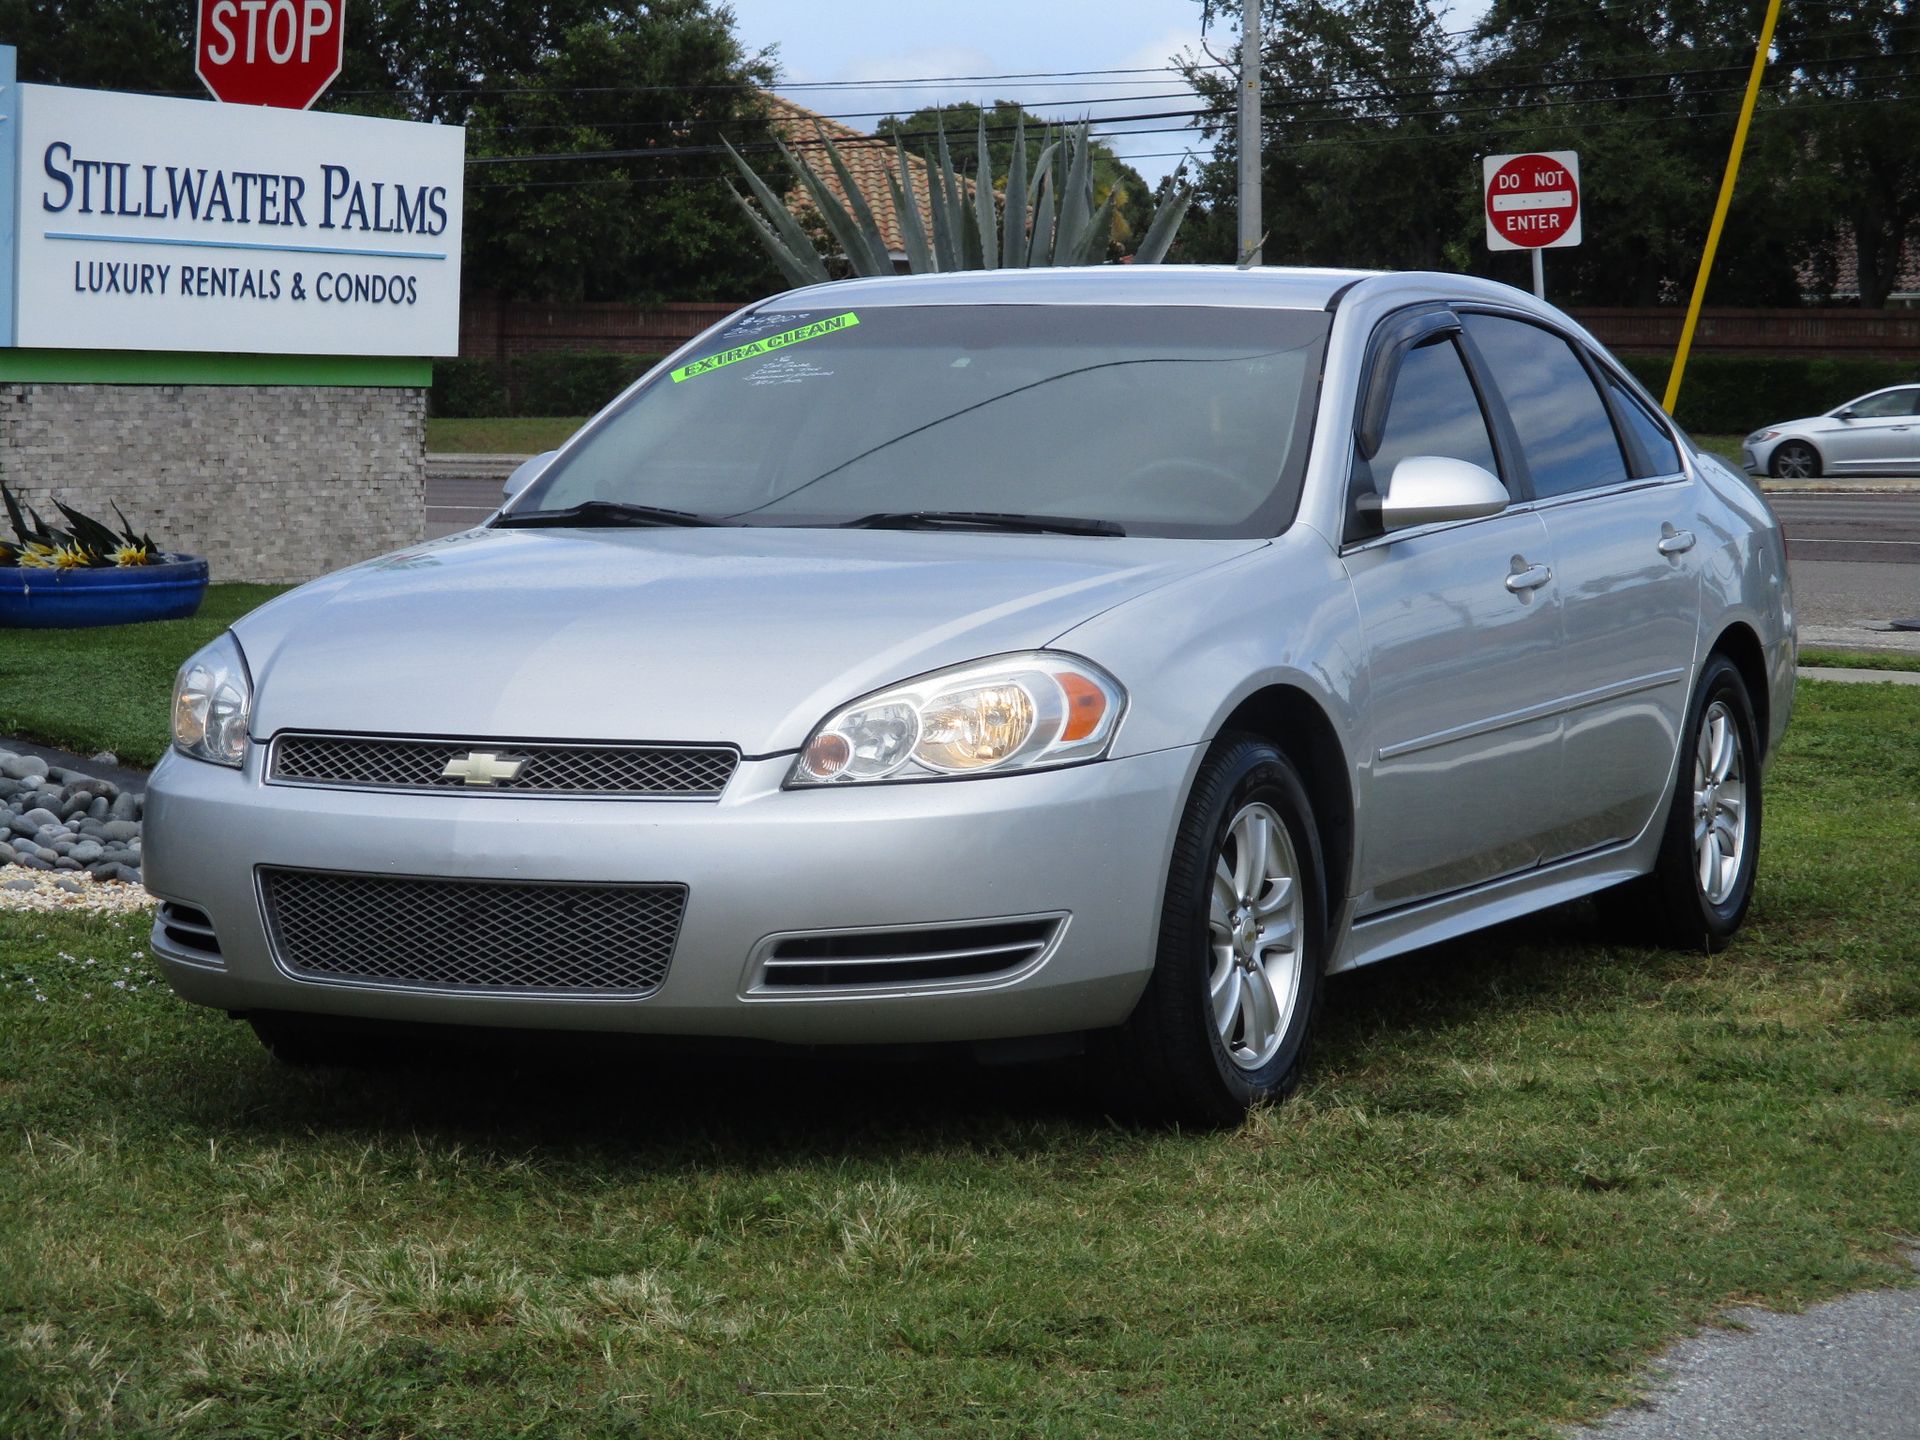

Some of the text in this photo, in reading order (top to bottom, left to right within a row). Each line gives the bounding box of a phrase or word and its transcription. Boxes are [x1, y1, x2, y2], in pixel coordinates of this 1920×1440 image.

[207, 0, 333, 65] STOP
[42, 141, 448, 236] STILLWATER PALMS
[1498, 170, 1564, 189] DO NOT
[1506, 213, 1560, 231] ENTER
[75, 261, 417, 305] LUXURY RENTALS & CONDOS
[684, 343, 763, 377] EXTRA
